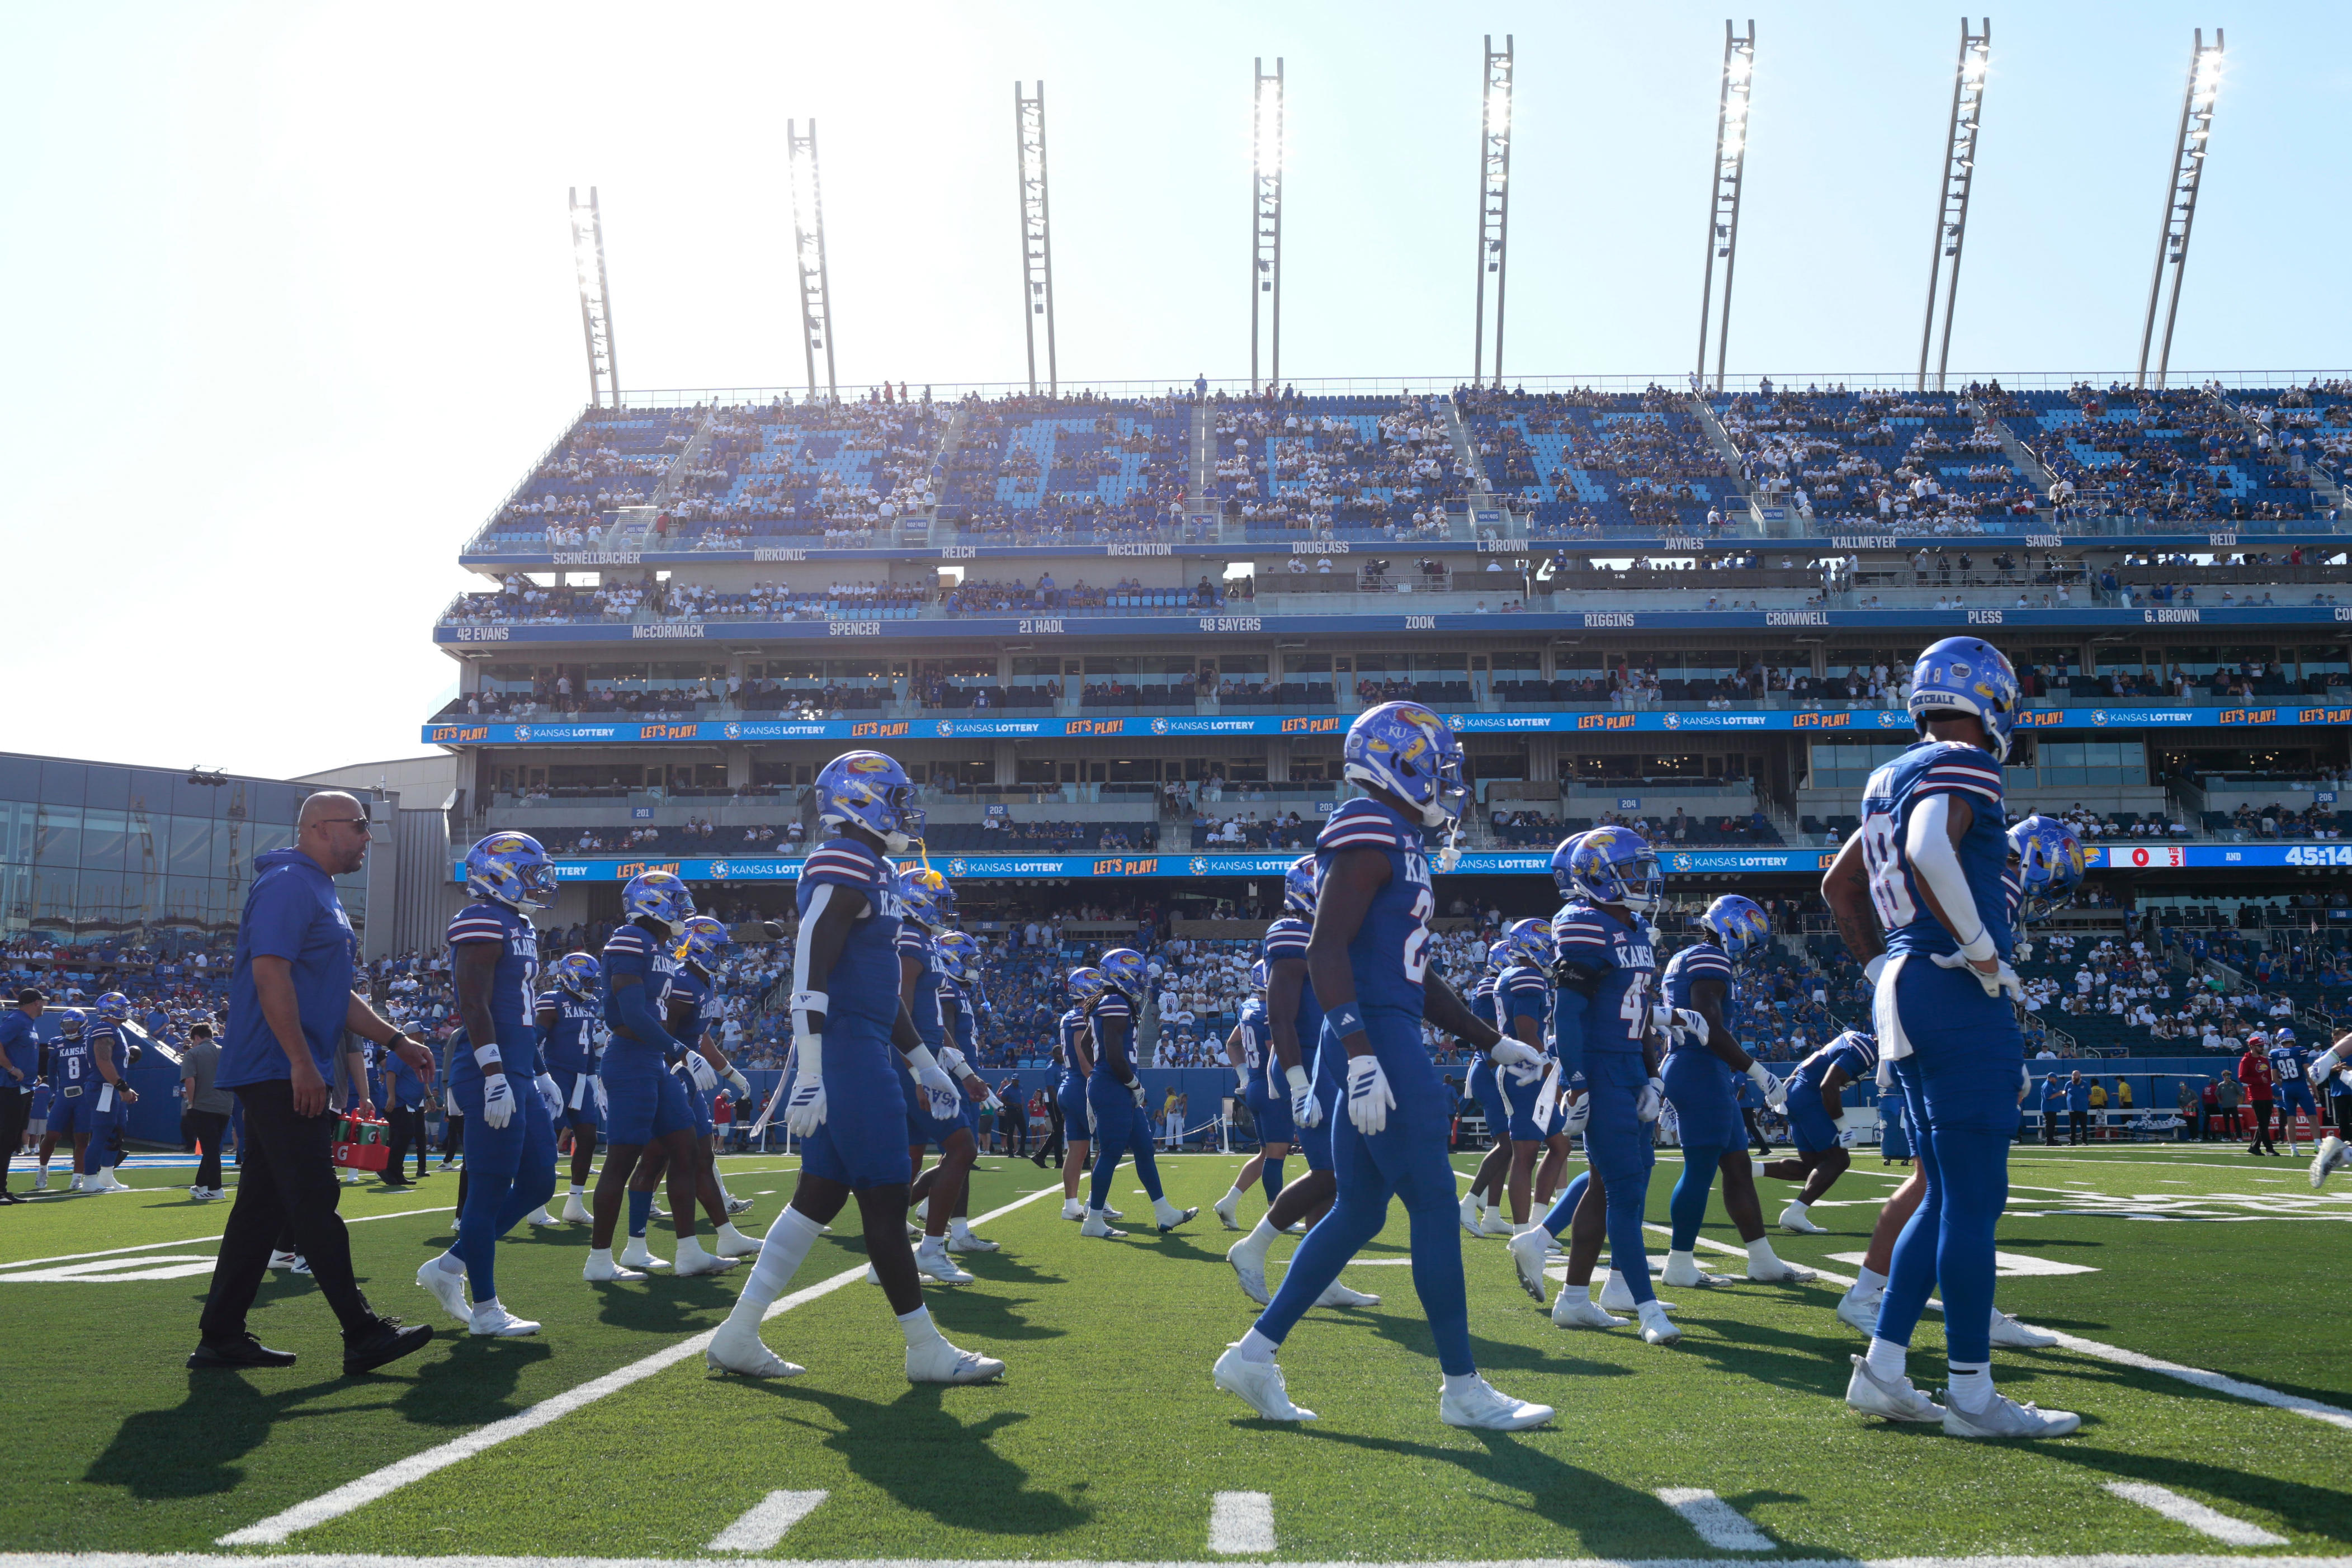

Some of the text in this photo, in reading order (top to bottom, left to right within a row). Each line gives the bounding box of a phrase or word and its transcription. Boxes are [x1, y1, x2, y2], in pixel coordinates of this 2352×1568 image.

[1477, 539, 1528, 552] L. BROWN
[1664, 537, 1704, 550] JAYNES
[1832, 536, 1897, 549] KALLMEYER
[2025, 535, 2062, 547] SANDS
[2210, 533, 2237, 546] REID
[942, 546, 976, 559] REICH
[1107, 543, 1172, 556] McCLINTON
[1292, 541, 1350, 554] DOUGLASS
[553, 552, 640, 564] SCHNELLBACHER
[754, 549, 806, 561] MRKONIC
[1584, 613, 1635, 627] RIGGINS
[1765, 612, 1829, 626] CROMWELL
[1967, 610, 2003, 624] PLESS
[2145, 608, 2199, 622] G. BROWN
[2333, 606, 2352, 621] CO
[829, 622, 880, 636] SPENCER
[1019, 620, 1065, 634] 21 HADL
[1199, 617, 1261, 632] 48 SAYERS
[1405, 616, 1435, 629] ZOOK
[456, 626, 509, 640] 42 EVANS
[632, 624, 705, 638] McCORMACK
[1924, 695, 1956, 705] CHALK
[1467, 718, 1505, 727] KANSAS
[1508, 718, 1551, 726] LOTTERY
[1578, 715, 1636, 730] LET'S PLAY!
[1683, 716, 1721, 725] KANSAS
[1723, 716, 1766, 725] LOTTERY
[1793, 712, 1850, 728] LET'S PLAY!
[2035, 711, 2063, 726] PLAY!
[2110, 713, 2148, 722] KANSAS
[2150, 713, 2193, 722] LOTTERY
[2219, 709, 2277, 725] LET'S PLAY!
[2299, 708, 2352, 724] LET'S PLAY
[743, 726, 781, 735] KANSAS
[782, 726, 825, 735] LOTTERY
[852, 722, 909, 737] LET'S PLAY!
[956, 724, 994, 733] KANSAS
[996, 724, 1039, 733] LOTTERY
[1066, 720, 1123, 735] LET'S PLAY!
[1171, 722, 1209, 730] KANSAS
[1211, 721, 1255, 730] LOTTERY
[1281, 717, 1339, 733] LET'S PLAY!
[432, 727, 488, 742] LET'S PLAY!
[533, 729, 570, 738] KANSAS
[572, 729, 615, 737] LOTTERY
[640, 725, 697, 739] LET'S PLAY!
[1388, 725, 1408, 739] KU
[990, 806, 1003, 814] 202
[1622, 800, 1636, 808] 204
[636, 809, 649, 817] 201
[1578, 853, 1588, 863] KU
[1695, 858, 1737, 866] KANSAS
[1740, 857, 1788, 866] LOTTERY
[1819, 853, 1839, 868] LET
[2132, 848, 2149, 867] 0
[2170, 855, 2179, 866] 3
[2226, 852, 2241, 861] AND
[732, 865, 773, 874] KANSAS
[776, 865, 804, 873] LOTT
[899, 861, 917, 873] AY!
[970, 863, 1012, 872] KANSAS
[1014, 863, 1063, 872] LOTTERY
[1093, 859, 1158, 875] LET'S PLAY!
[1212, 862, 1253, 871] KANSAS
[1256, 861, 1295, 870] LOTTE
[1454, 859, 1547, 868] KANSAS LOTTERY
[554, 867, 588, 875] TTERY
[617, 862, 645, 879] LET'S
[1616, 945, 1656, 969] KANSA
[564, 1006, 595, 1018] KANSA
[578, 1019, 589, 1055] 4
[363, 1040, 374, 1050] SAS
[59, 1047, 85, 1057] KANSA
[68, 1056, 80, 1079] 8
[2277, 1058, 2298, 1080] 98
[337, 1145, 349, 1161] G
